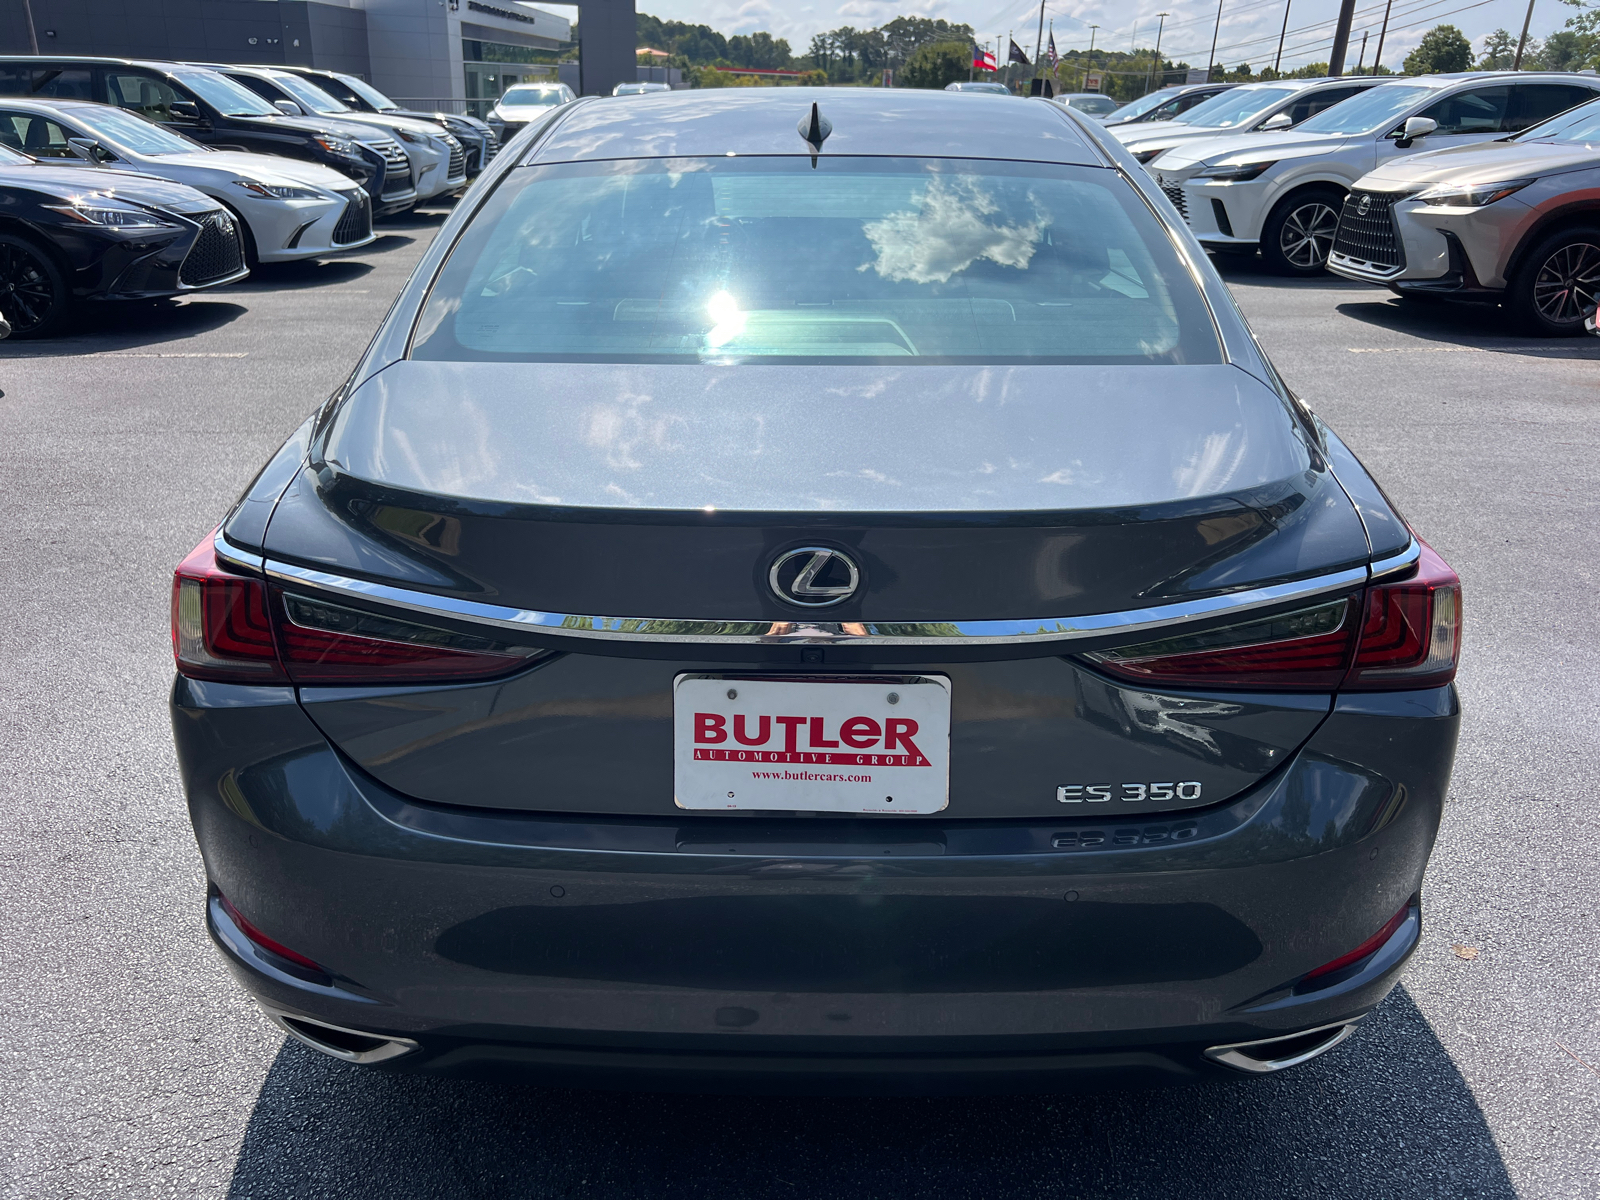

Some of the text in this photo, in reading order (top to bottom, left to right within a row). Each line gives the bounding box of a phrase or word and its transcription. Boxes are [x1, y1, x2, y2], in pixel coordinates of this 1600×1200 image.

[695, 750, 923, 766] AUTOMOTIVE GROUP
[752, 770, 872, 783] www.butlercars.com
[1056, 781, 1202, 803] ES 350
